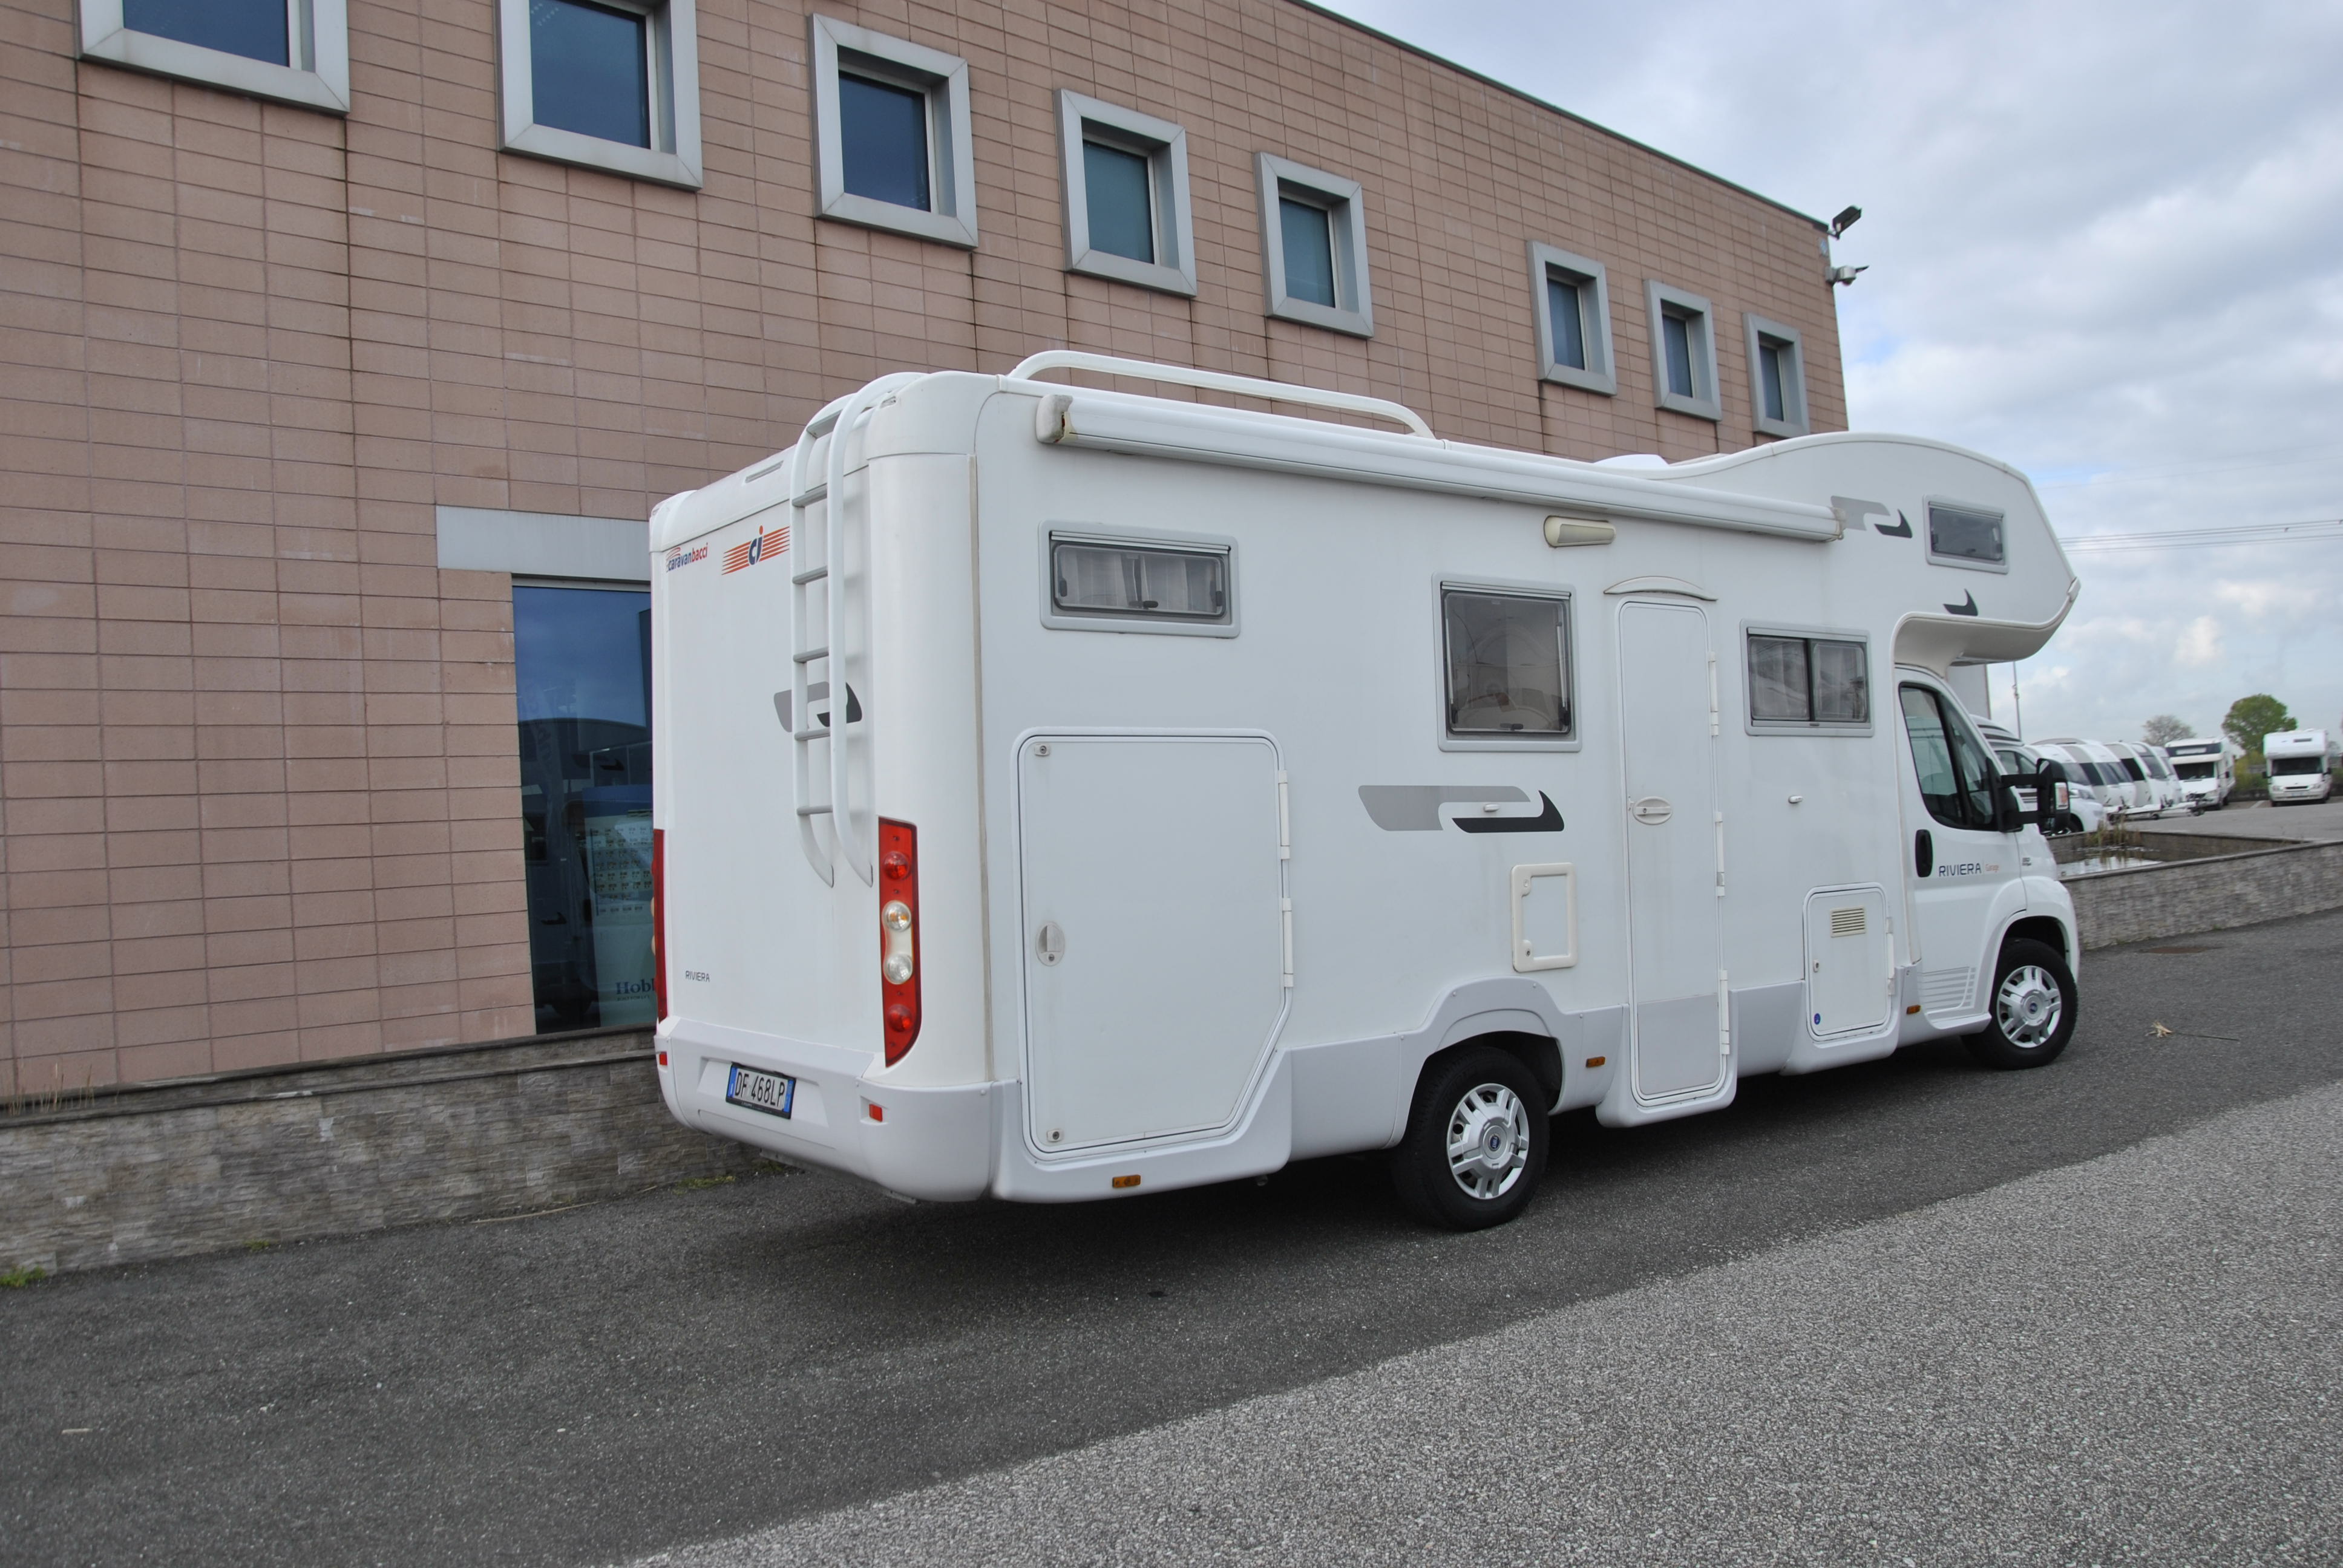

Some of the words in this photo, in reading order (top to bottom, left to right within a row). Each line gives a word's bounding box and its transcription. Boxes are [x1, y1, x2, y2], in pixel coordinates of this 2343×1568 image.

[668, 542, 709, 571] caravanbacci
[1939, 863, 1982, 877] RIVIERA
[685, 970, 710, 982] RIVIERA
[735, 1071, 749, 1098] DF
[751, 1075, 785, 1107] 468LP
